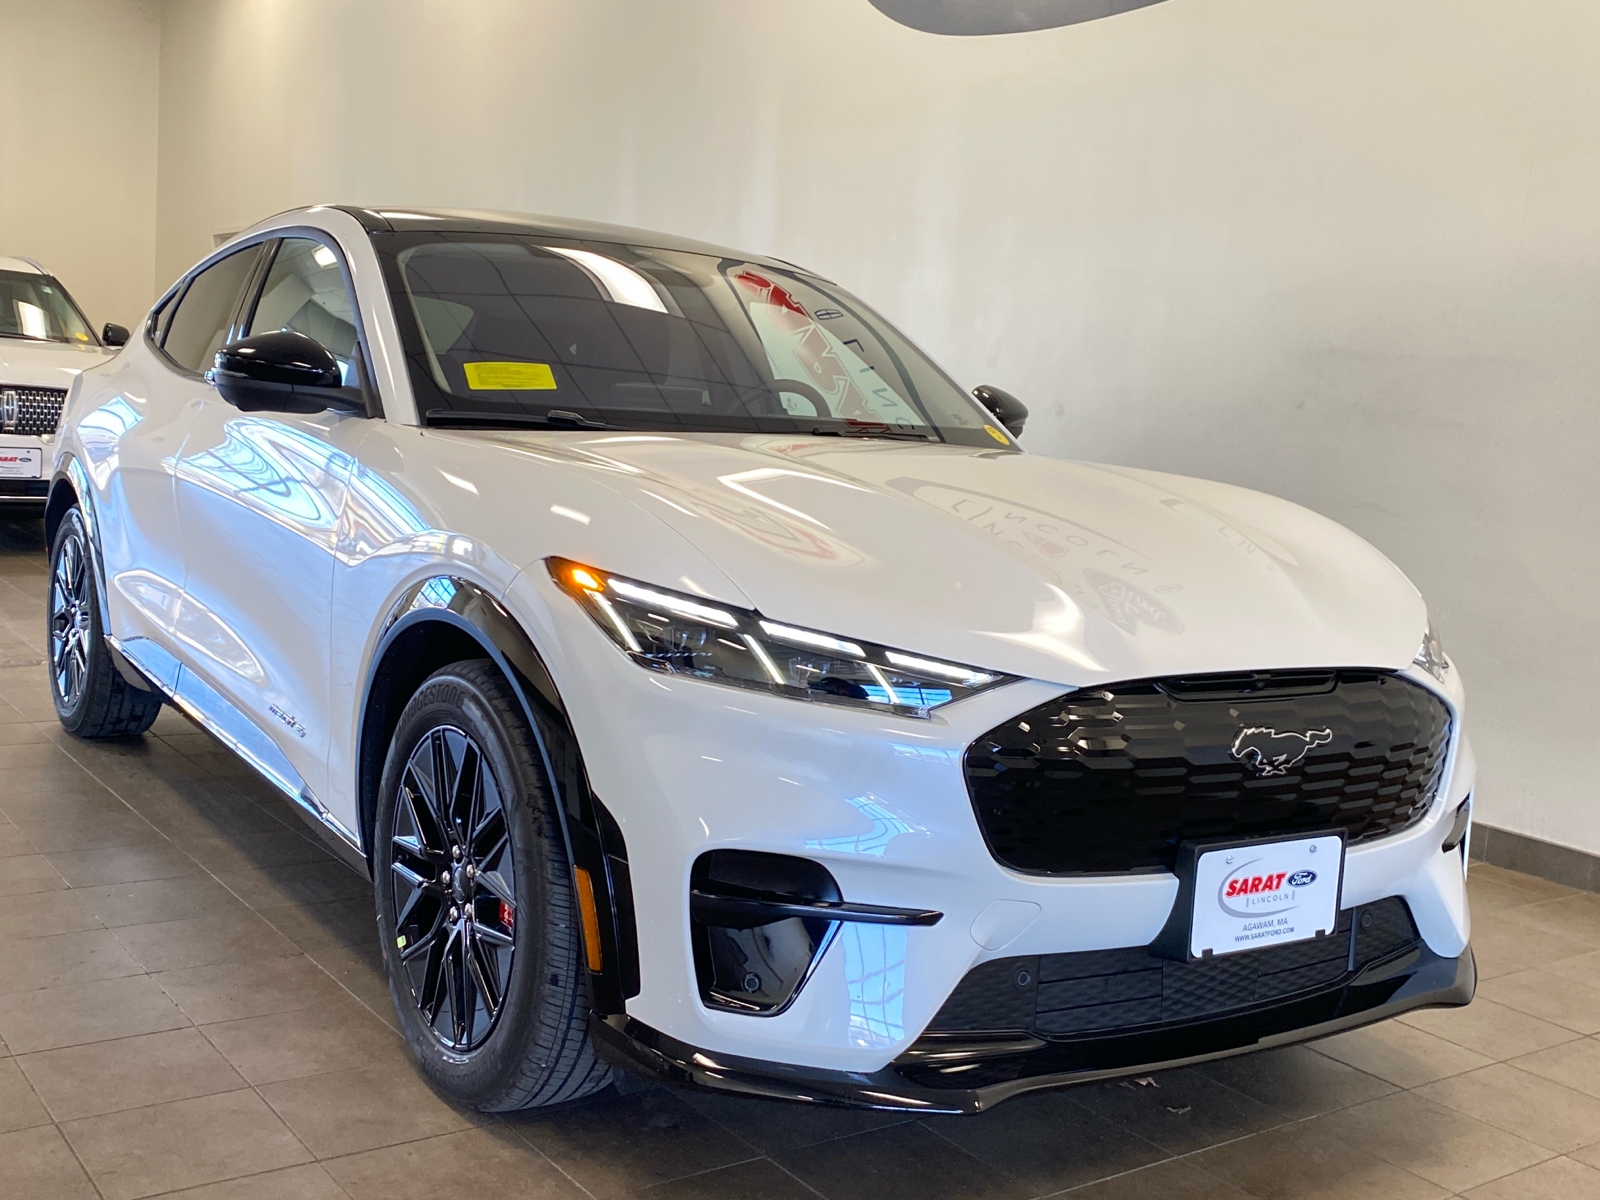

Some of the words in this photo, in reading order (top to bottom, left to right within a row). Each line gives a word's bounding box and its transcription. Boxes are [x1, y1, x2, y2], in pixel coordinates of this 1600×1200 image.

[396, 683, 467, 737] IDGESTONE
[1225, 871, 1288, 898] SARAT
[1291, 872, 1312, 885] Ford
[1252, 894, 1289, 905] LINCOLN
[1242, 919, 1275, 932] AGAWAM,
[1277, 917, 1288, 926] MA
[1234, 926, 1294, 942] WWW.SARATFORD.COM
